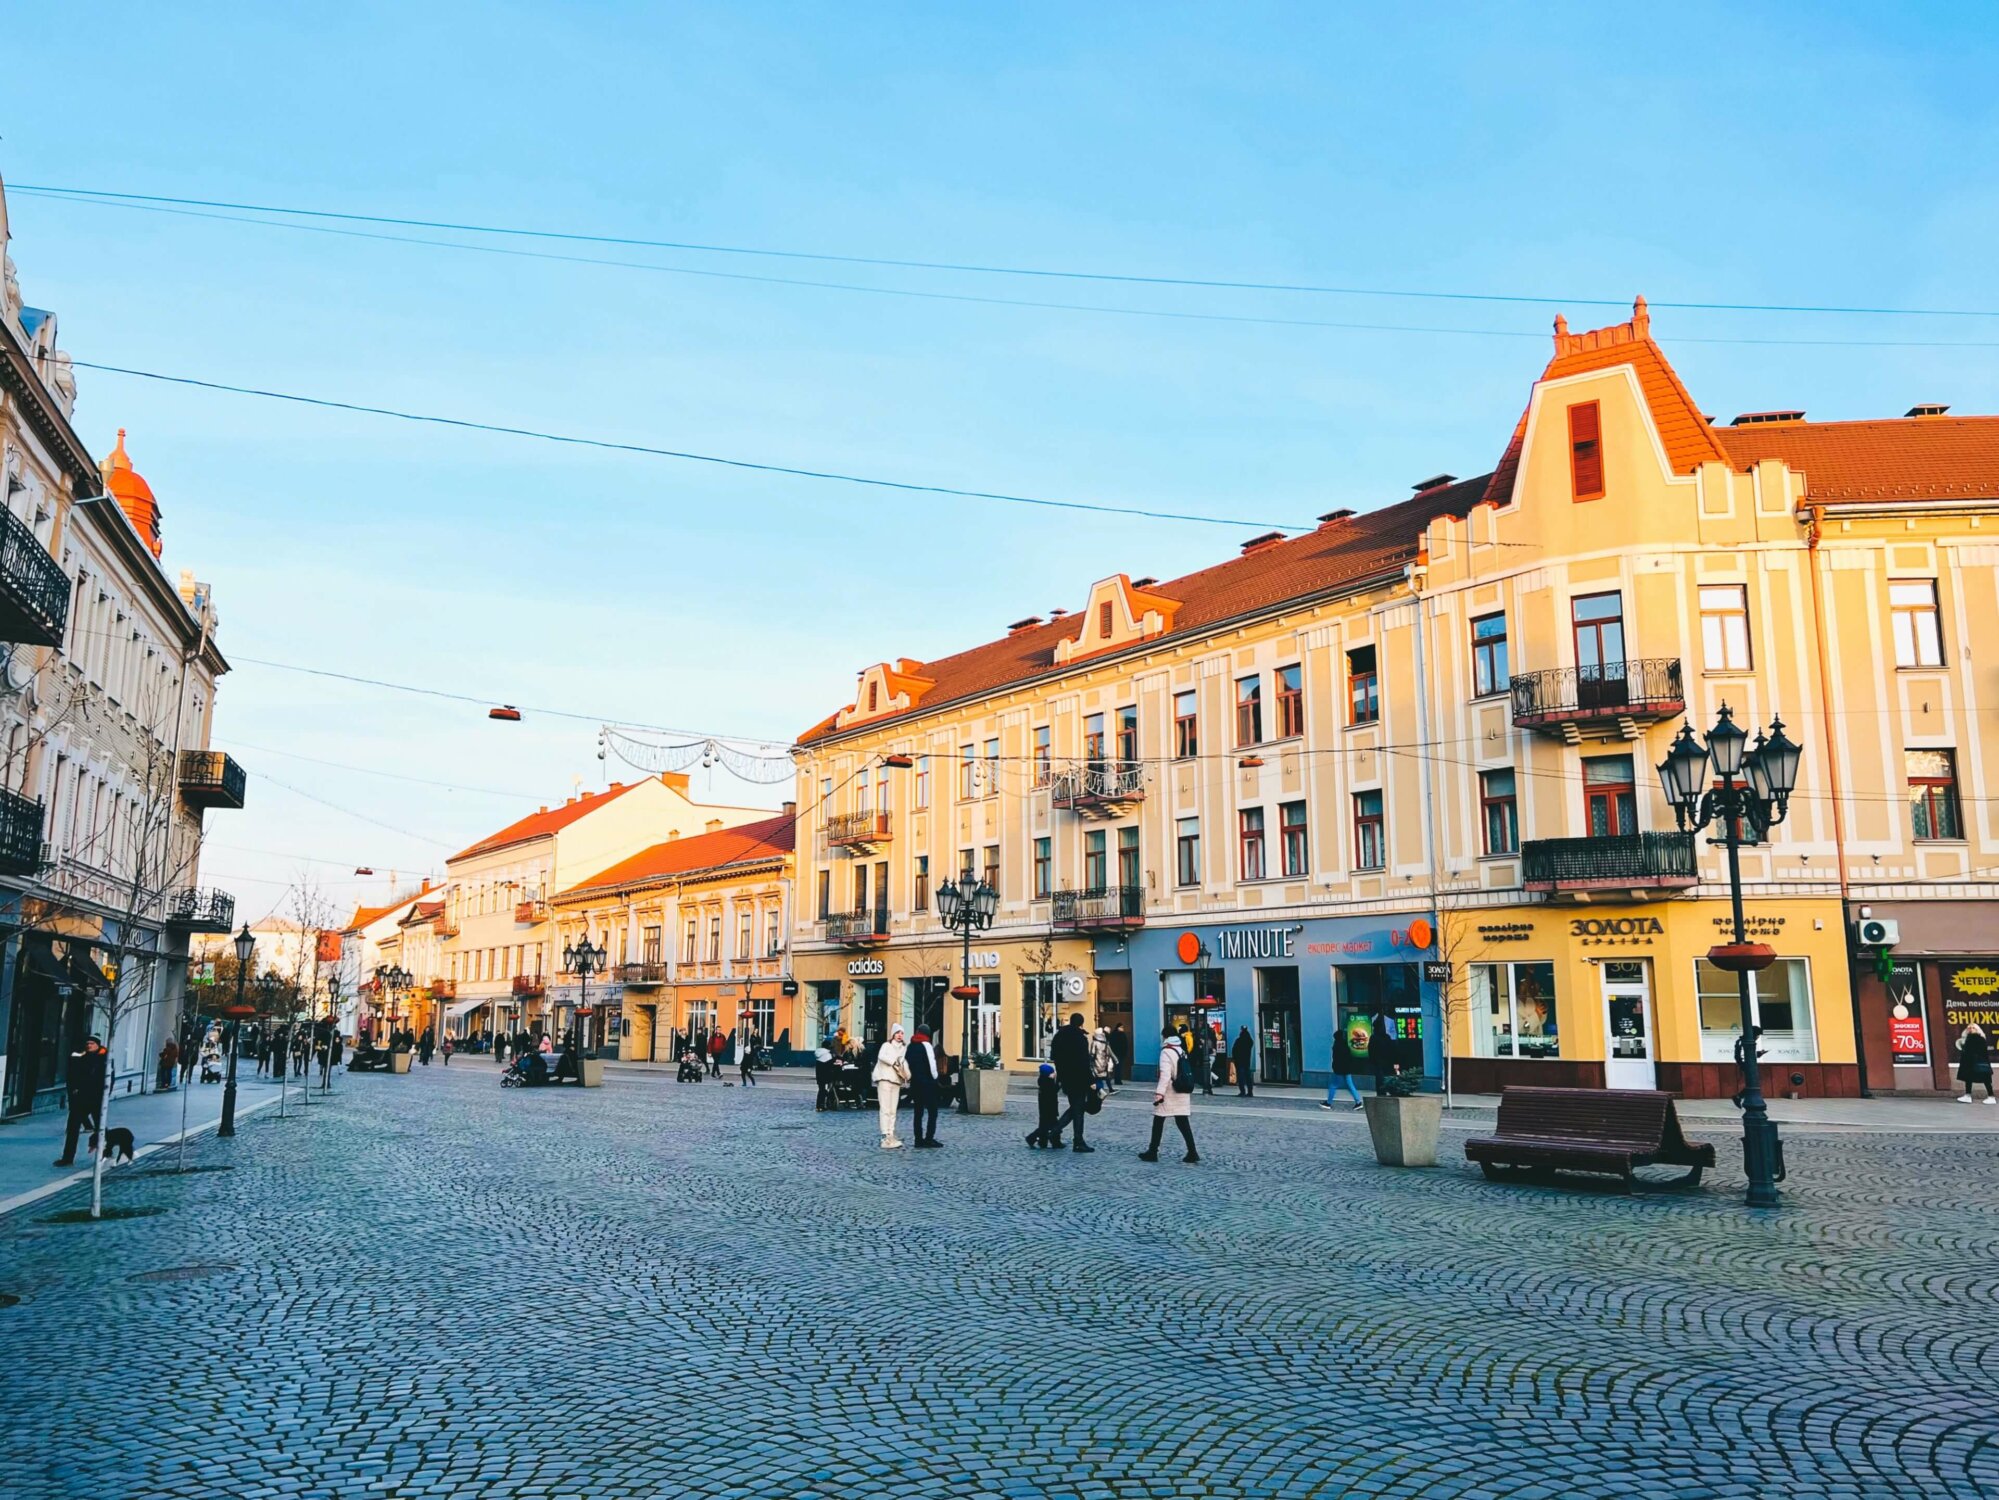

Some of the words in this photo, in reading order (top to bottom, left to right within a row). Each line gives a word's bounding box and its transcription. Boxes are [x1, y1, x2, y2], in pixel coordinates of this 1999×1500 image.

[1569, 917, 1664, 936] ЗОЛОТА
[1712, 915, 1786, 926] ювлірна
[1217, 928, 1294, 959] 1MINUTE
[1307, 942, 1339, 956] експрес
[1342, 940, 1372, 955] маркет
[848, 957, 884, 975] adidas
[1958, 977, 1997, 986] ЧЕТВЕР
[1946, 1000, 1967, 1008] День
